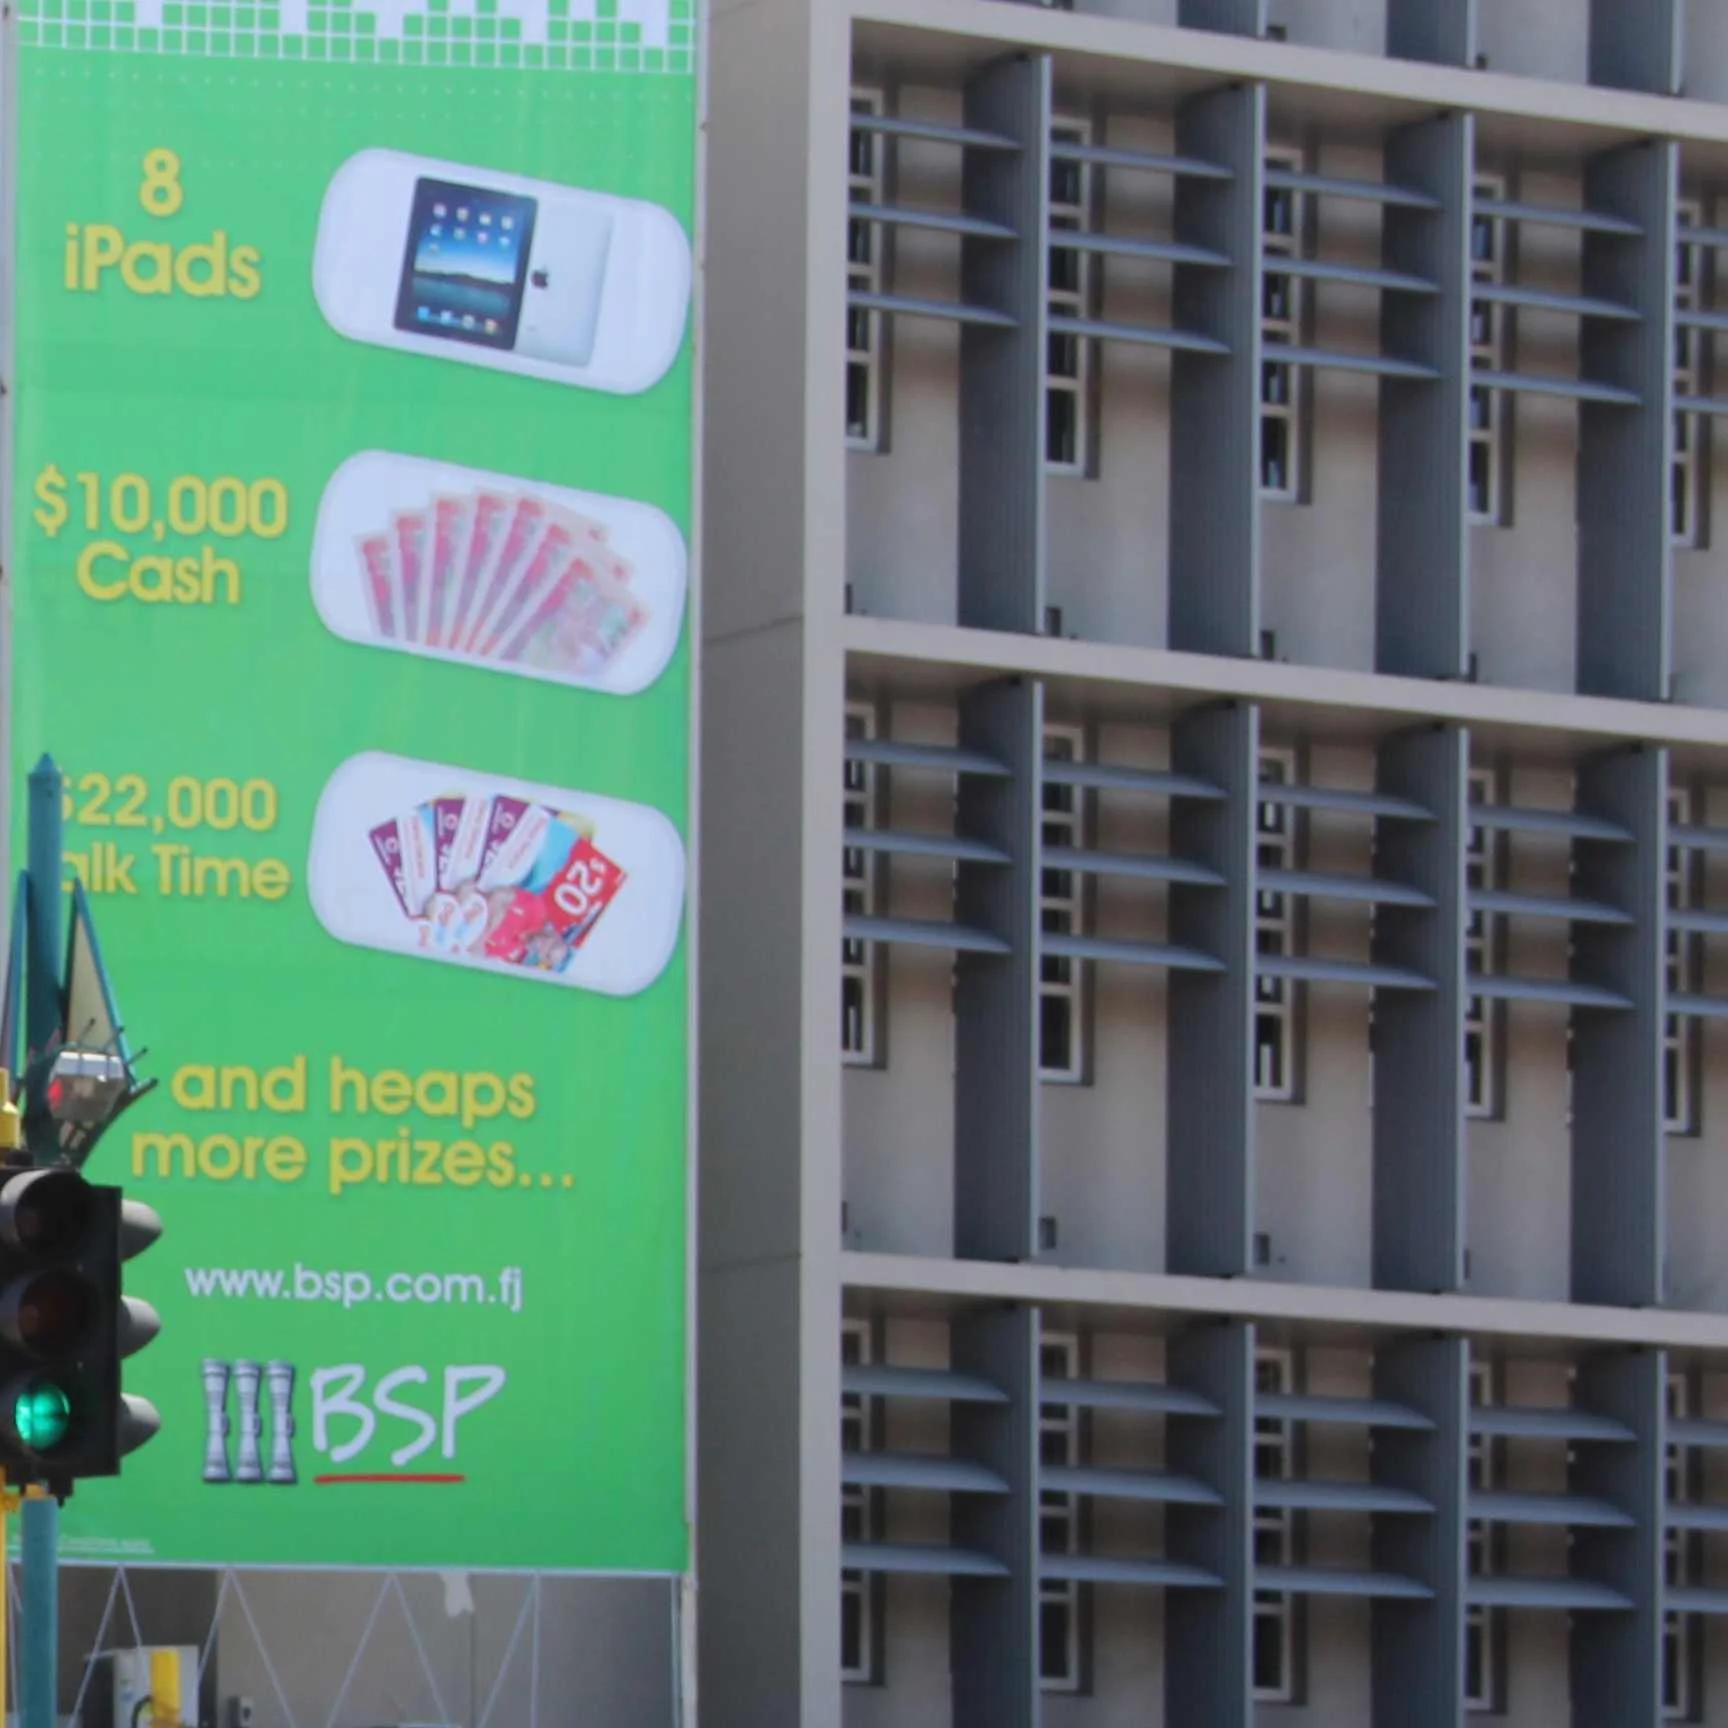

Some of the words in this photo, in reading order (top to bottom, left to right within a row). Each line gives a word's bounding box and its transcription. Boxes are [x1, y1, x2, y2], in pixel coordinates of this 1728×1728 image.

[140, 148, 183, 217] 8
[63, 222, 262, 299] iPads
[33, 464, 288, 542] $10,000
[76, 539, 240, 605] Cash
[60, 842, 139, 894] alk
[151, 843, 293, 900] Time
[170, 1054, 307, 1113] and
[329, 1057, 536, 1128] heaps
[131, 1130, 307, 1181] more
[329, 1130, 575, 1194] prizes...
[184, 1262, 524, 1312] www.bsp.com.fj
[310, 1362, 507, 1466] BSP
